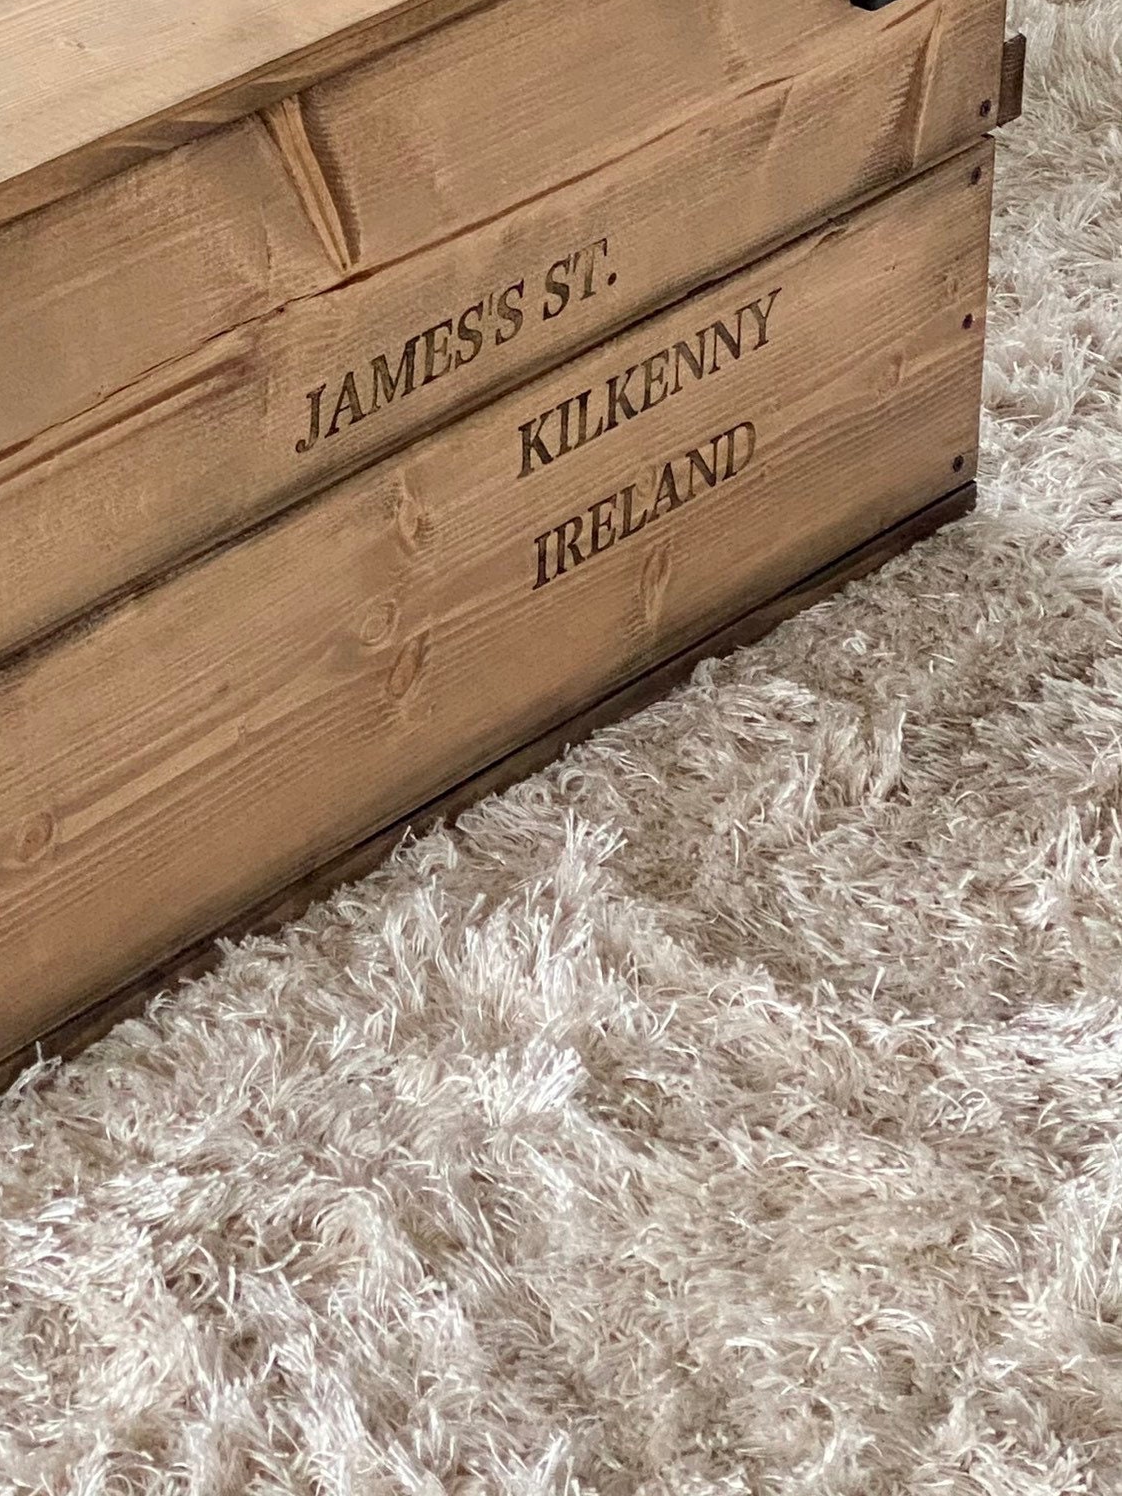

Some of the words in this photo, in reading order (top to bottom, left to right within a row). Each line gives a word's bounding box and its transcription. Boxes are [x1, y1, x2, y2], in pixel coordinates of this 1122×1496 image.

[294, 279, 525, 454] JAMES'S
[541, 238, 618, 321] ST.
[516, 287, 783, 479] KILKENNY
[531, 420, 757, 591] IRELAND
